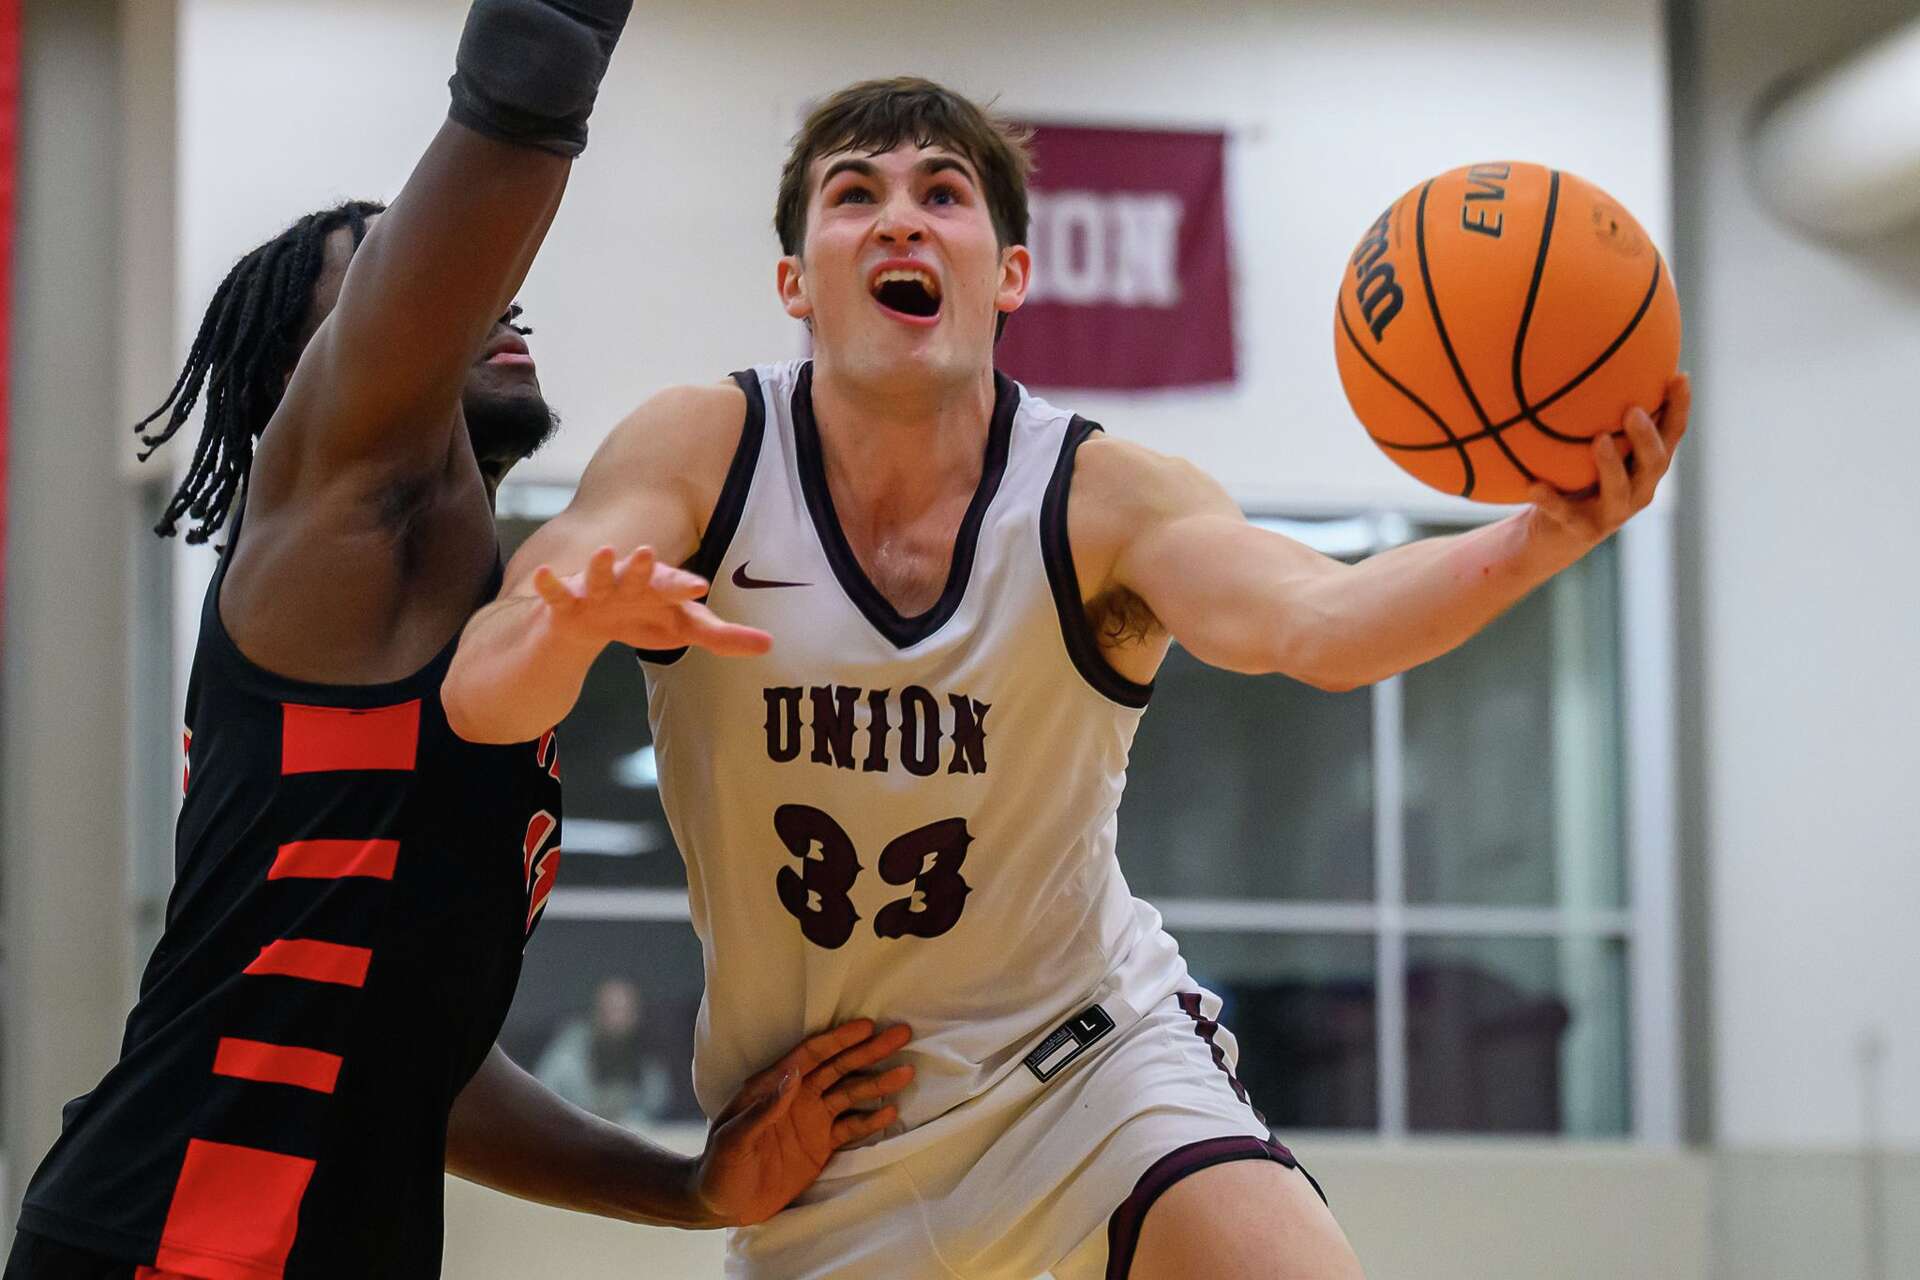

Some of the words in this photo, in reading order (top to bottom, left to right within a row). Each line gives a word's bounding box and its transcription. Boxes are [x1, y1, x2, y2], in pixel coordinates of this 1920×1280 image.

[763, 684, 992, 776] UNION
[774, 804, 976, 950] 33
[1080, 1020, 1096, 1031] L
